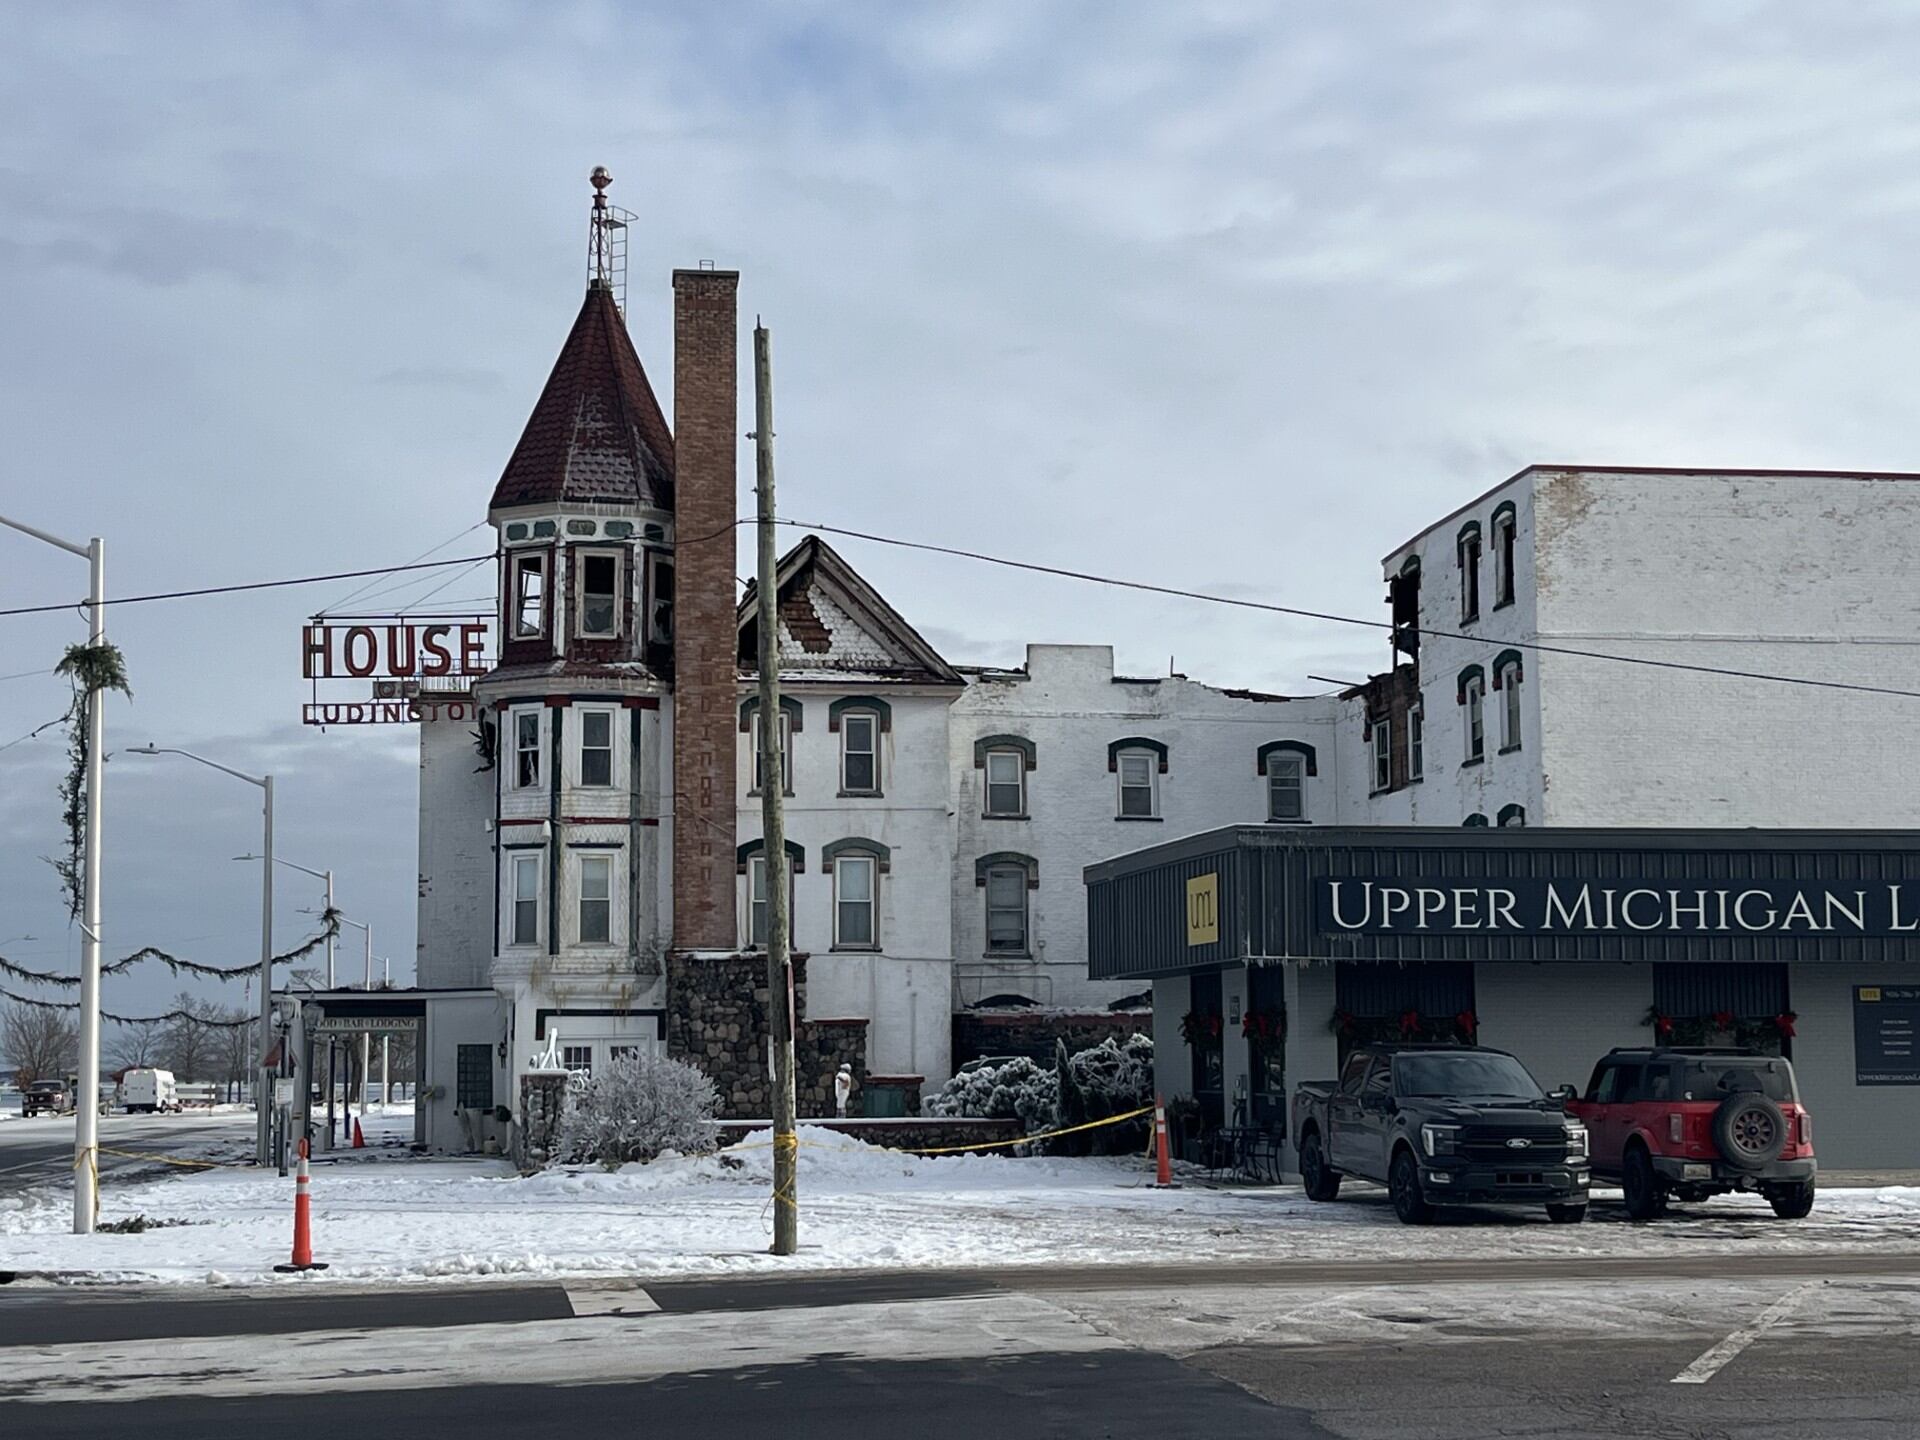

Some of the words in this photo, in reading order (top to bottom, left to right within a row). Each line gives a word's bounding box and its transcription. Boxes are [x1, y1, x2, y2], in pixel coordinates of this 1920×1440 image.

[302, 623, 488, 678] HOUSE
[1327, 880, 1525, 930] UPPER
[1540, 881, 1867, 931] MICHIGAN
[1886, 884, 1920, 931] L
[343, 1017, 364, 1028] BAR
[370, 1017, 415, 1028] LODGING
